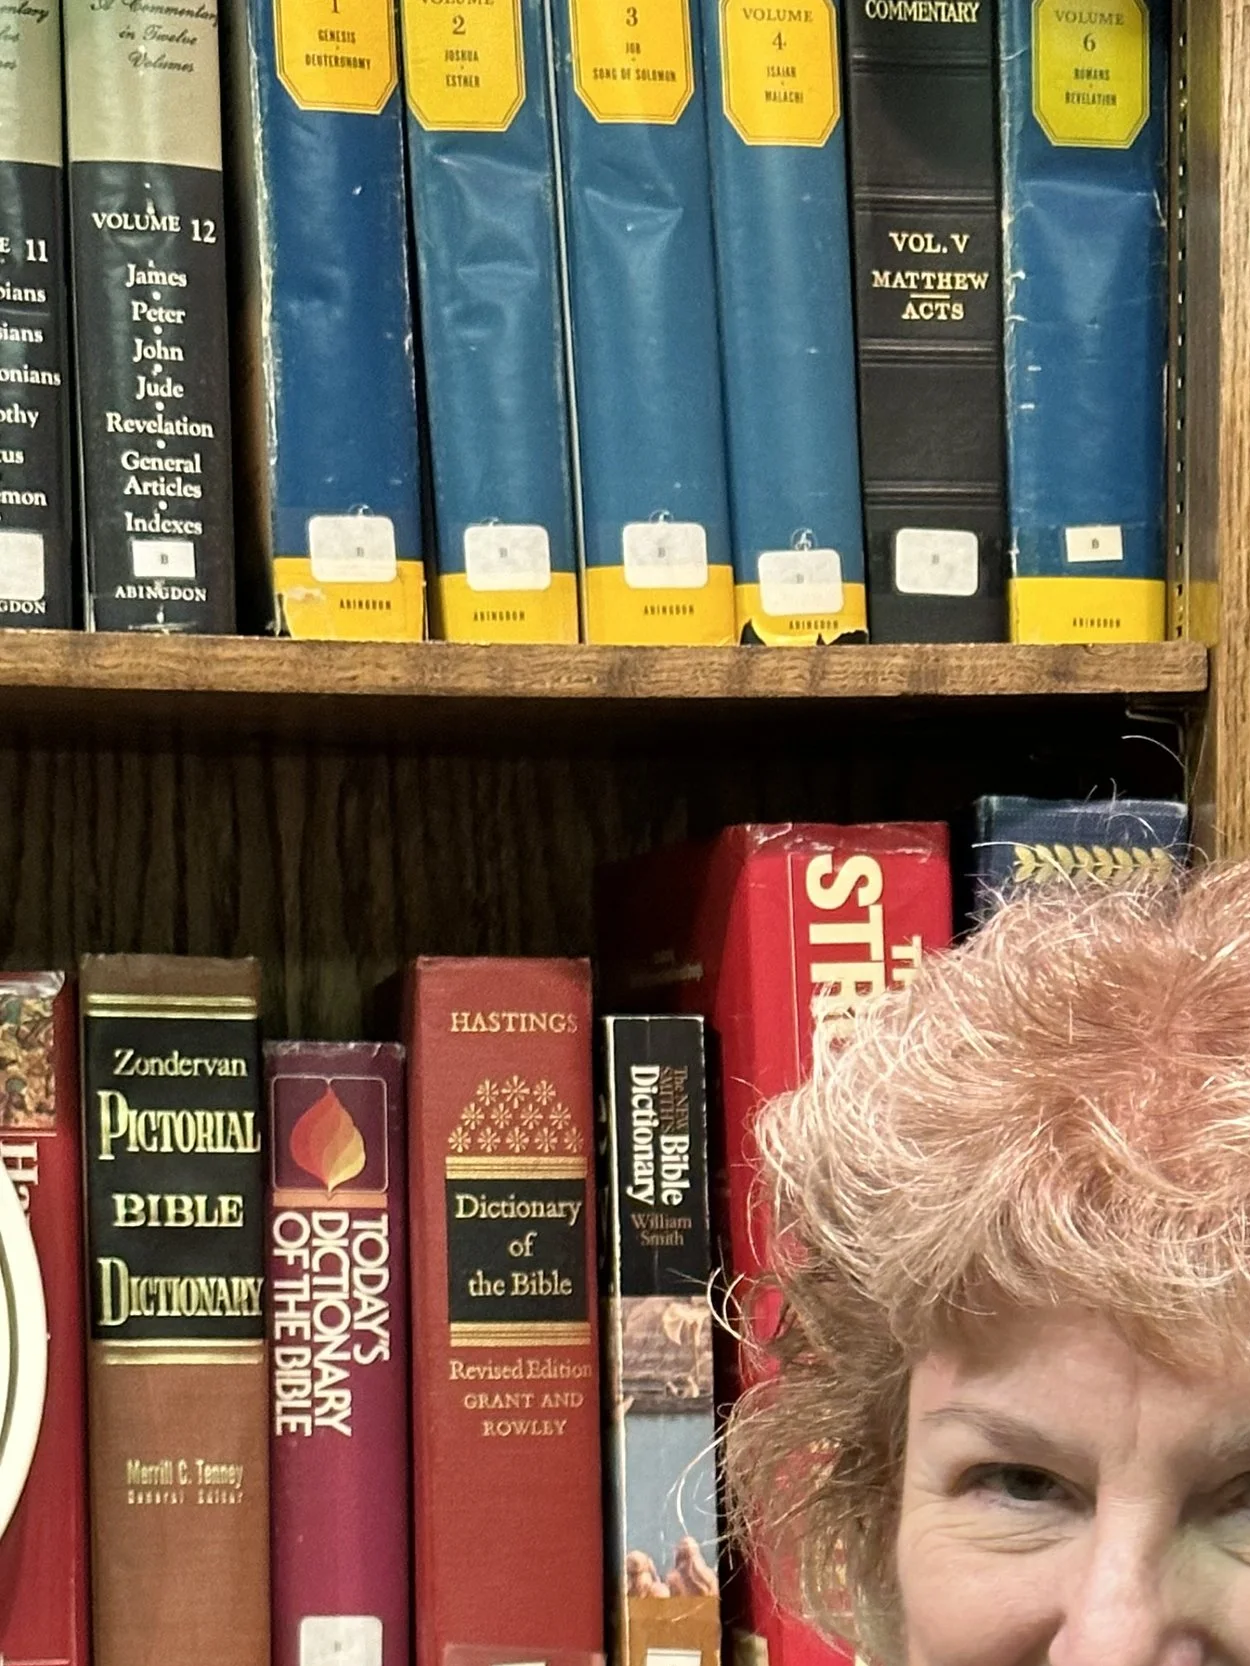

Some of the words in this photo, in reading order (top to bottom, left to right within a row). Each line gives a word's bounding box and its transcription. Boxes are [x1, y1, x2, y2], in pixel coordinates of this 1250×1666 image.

[625, 6, 639, 27] 3
[743, 8, 814, 23] VOLUME
[864, 0, 981, 24] COMMENTARY
[1053, 9, 1124, 26] VOLUME
[142, 24, 198, 46] Twelve
[452, 15, 466, 35] 2
[318, 29, 357, 45] GENESIS
[771, 32, 787, 51] 4
[1083, 32, 1097, 53] 6
[444, 48, 480, 64] JOSHUA
[625, 42, 641, 55] JOB
[128, 51, 195, 73] Volumes
[305, 53, 371, 71] DEUTERONOMY
[766, 65, 797, 79] ISAIAH
[445, 74, 480, 89] ESTHER
[1074, 66, 1110, 81] ROMANS
[764, 89, 804, 104] MALACHI
[1064, 91, 1118, 107] REVELATION
[91, 212, 181, 233] VOLUME
[191, 219, 216, 243] 12
[25, 239, 48, 263] 11
[889, 231, 948, 253] VOL.
[953, 233, 969, 252] V
[126, 263, 188, 288] James
[872, 270, 990, 291] MATTHEW
[131, 301, 186, 325] Peter
[901, 301, 965, 322] ACTS
[133, 339, 184, 364] John
[136, 376, 184, 400] Jude
[106, 412, 215, 439] Revelation
[121, 451, 202, 474] General
[124, 476, 202, 499] Articles
[125, 512, 203, 535] Indexes
[115, 585, 206, 602] ABINGDON
[450, 1011, 579, 1033] HASTINGS
[113, 1048, 248, 1077] Zondervan
[97, 1089, 262, 1161] PICTORIAL
[626, 1065, 661, 1206] Dictionary
[660, 1134, 690, 1206] Bible
[112, 1193, 244, 1228] BIBLE
[455, 1192, 582, 1227] Dictionary
[630, 1213, 692, 1230] William
[272, 1211, 310, 1269] OF
[508, 1233, 536, 1260] of
[640, 1229, 684, 1246] Smith
[97, 1257, 264, 1327] DICTIONARY
[352, 1213, 391, 1366] TODAY'S
[468, 1272, 508, 1296] the
[510, 1270, 572, 1297] Bible
[273, 1278, 311, 1341] THE
[311, 1211, 353, 1438] DICTIONARY
[449, 1359, 523, 1381] Revised
[525, 1359, 593, 1381] Edition
[274, 1347, 313, 1438] BIBLE
[464, 1392, 535, 1409] GRANT
[540, 1392, 584, 1408] AND
[482, 1419, 567, 1437] ROWLEY
[126, 1459, 173, 1486] Merrill
[177, 1459, 192, 1485] C.
[196, 1460, 244, 1489] Tenney
